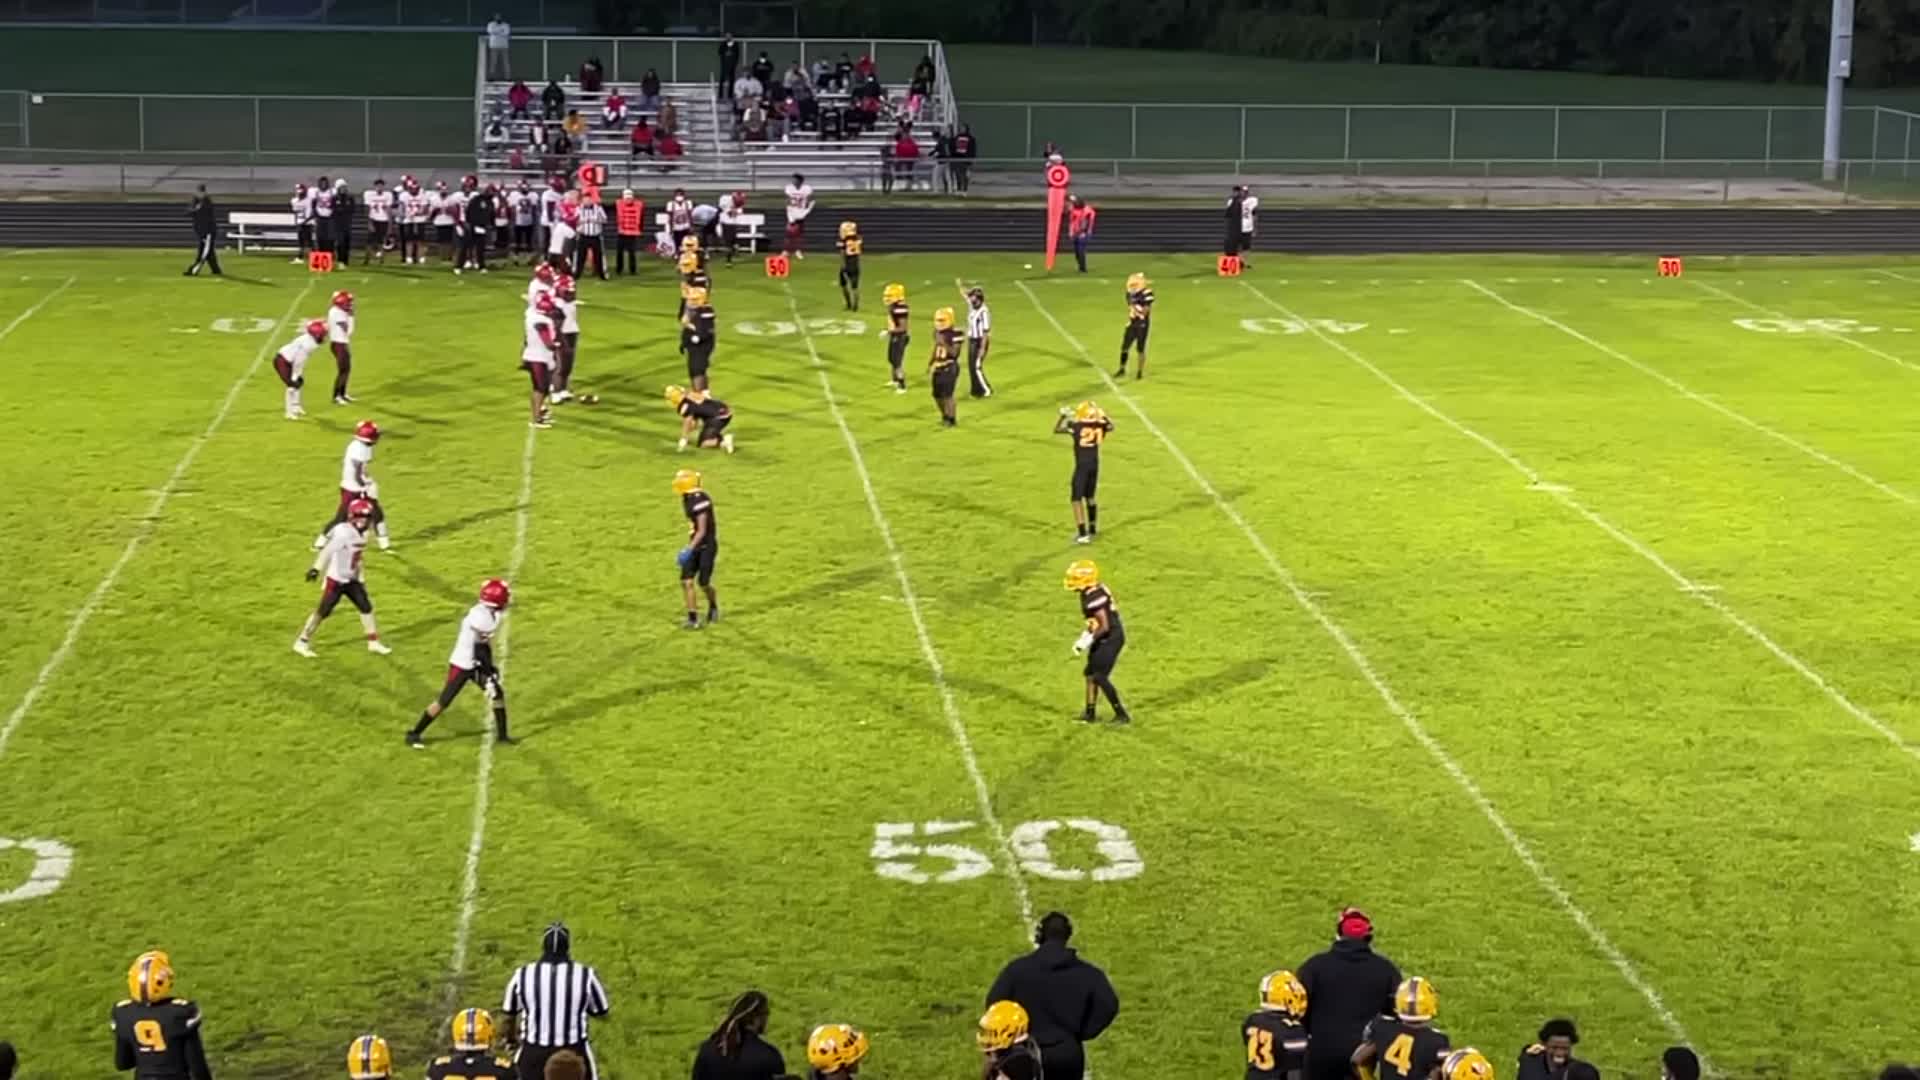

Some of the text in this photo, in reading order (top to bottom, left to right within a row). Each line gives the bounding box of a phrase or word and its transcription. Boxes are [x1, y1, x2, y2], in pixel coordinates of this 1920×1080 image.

[311, 253, 330, 270] 40
[768, 259, 787, 276] 50
[1220, 257, 1238, 275] 40
[1662, 260, 1680, 277] 30
[1080, 427, 1103, 447] 21
[870, 819, 1145, 883] 50
[133, 1020, 167, 1052] 9
[1246, 1026, 1276, 1071] 13
[1384, 1033, 1415, 1076] 4
